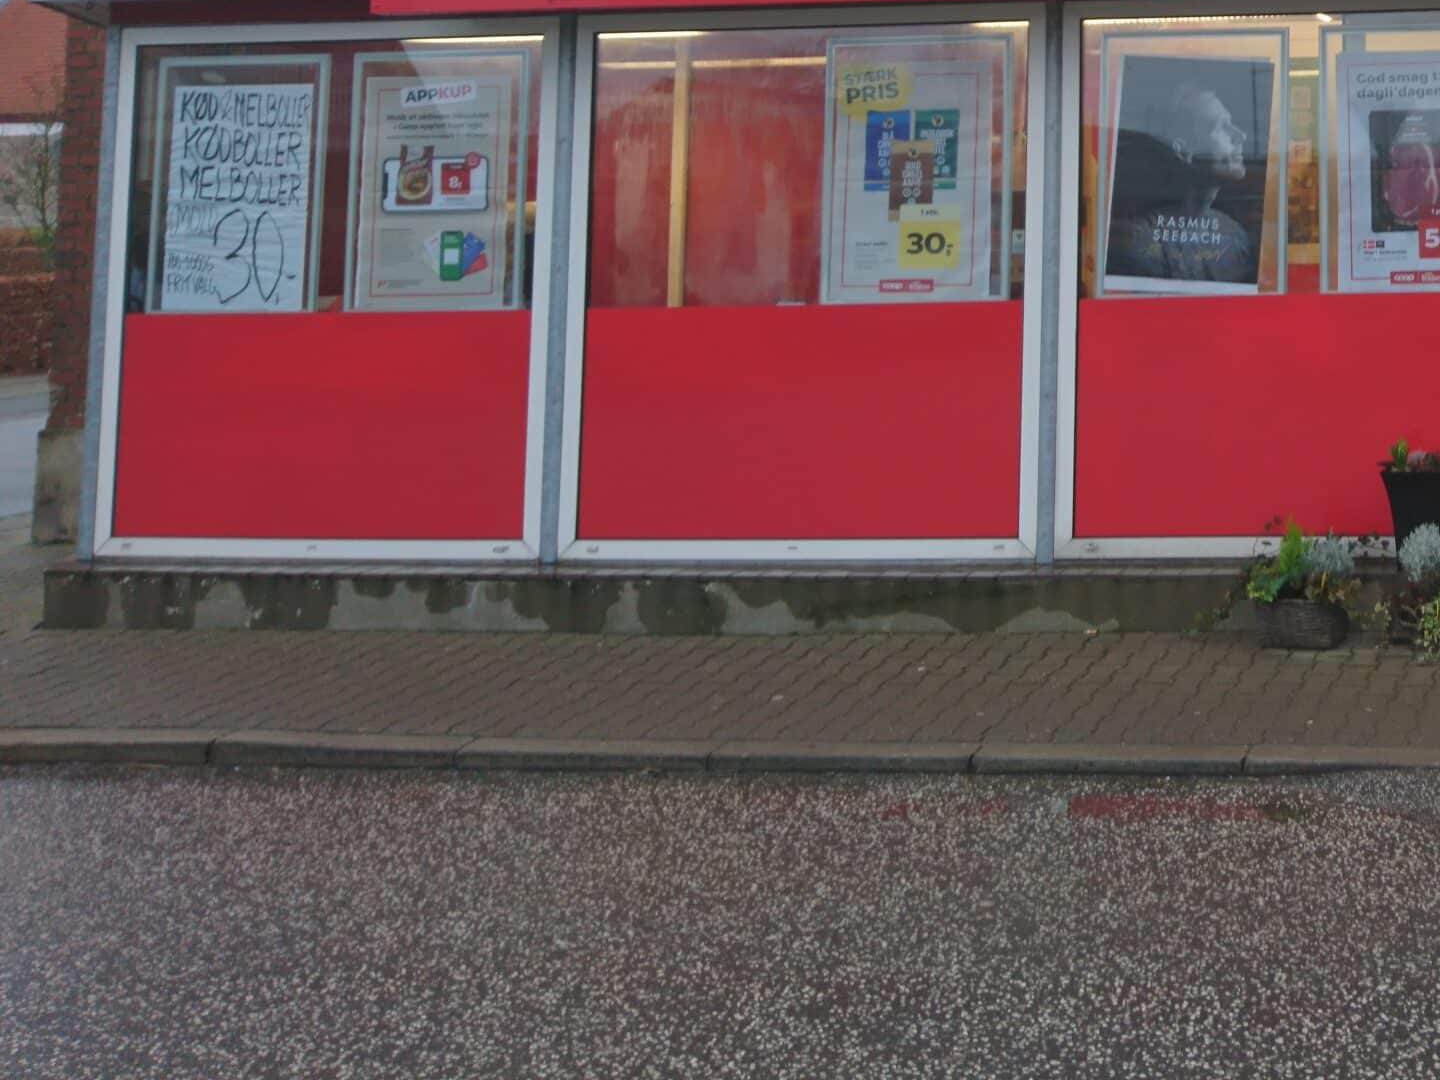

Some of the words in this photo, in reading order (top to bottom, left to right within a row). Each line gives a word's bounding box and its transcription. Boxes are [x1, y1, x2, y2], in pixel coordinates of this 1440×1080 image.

[1388, 72, 1429, 85] smag
[405, 83, 473, 105] APPKUP
[846, 82, 899, 105] PRIS
[184, 123, 301, 170] KØDBOLLER
[180, 165, 301, 207] MELBOLLER
[1156, 214, 1220, 231] RASMUS
[1152, 228, 1221, 245] SEEBACH
